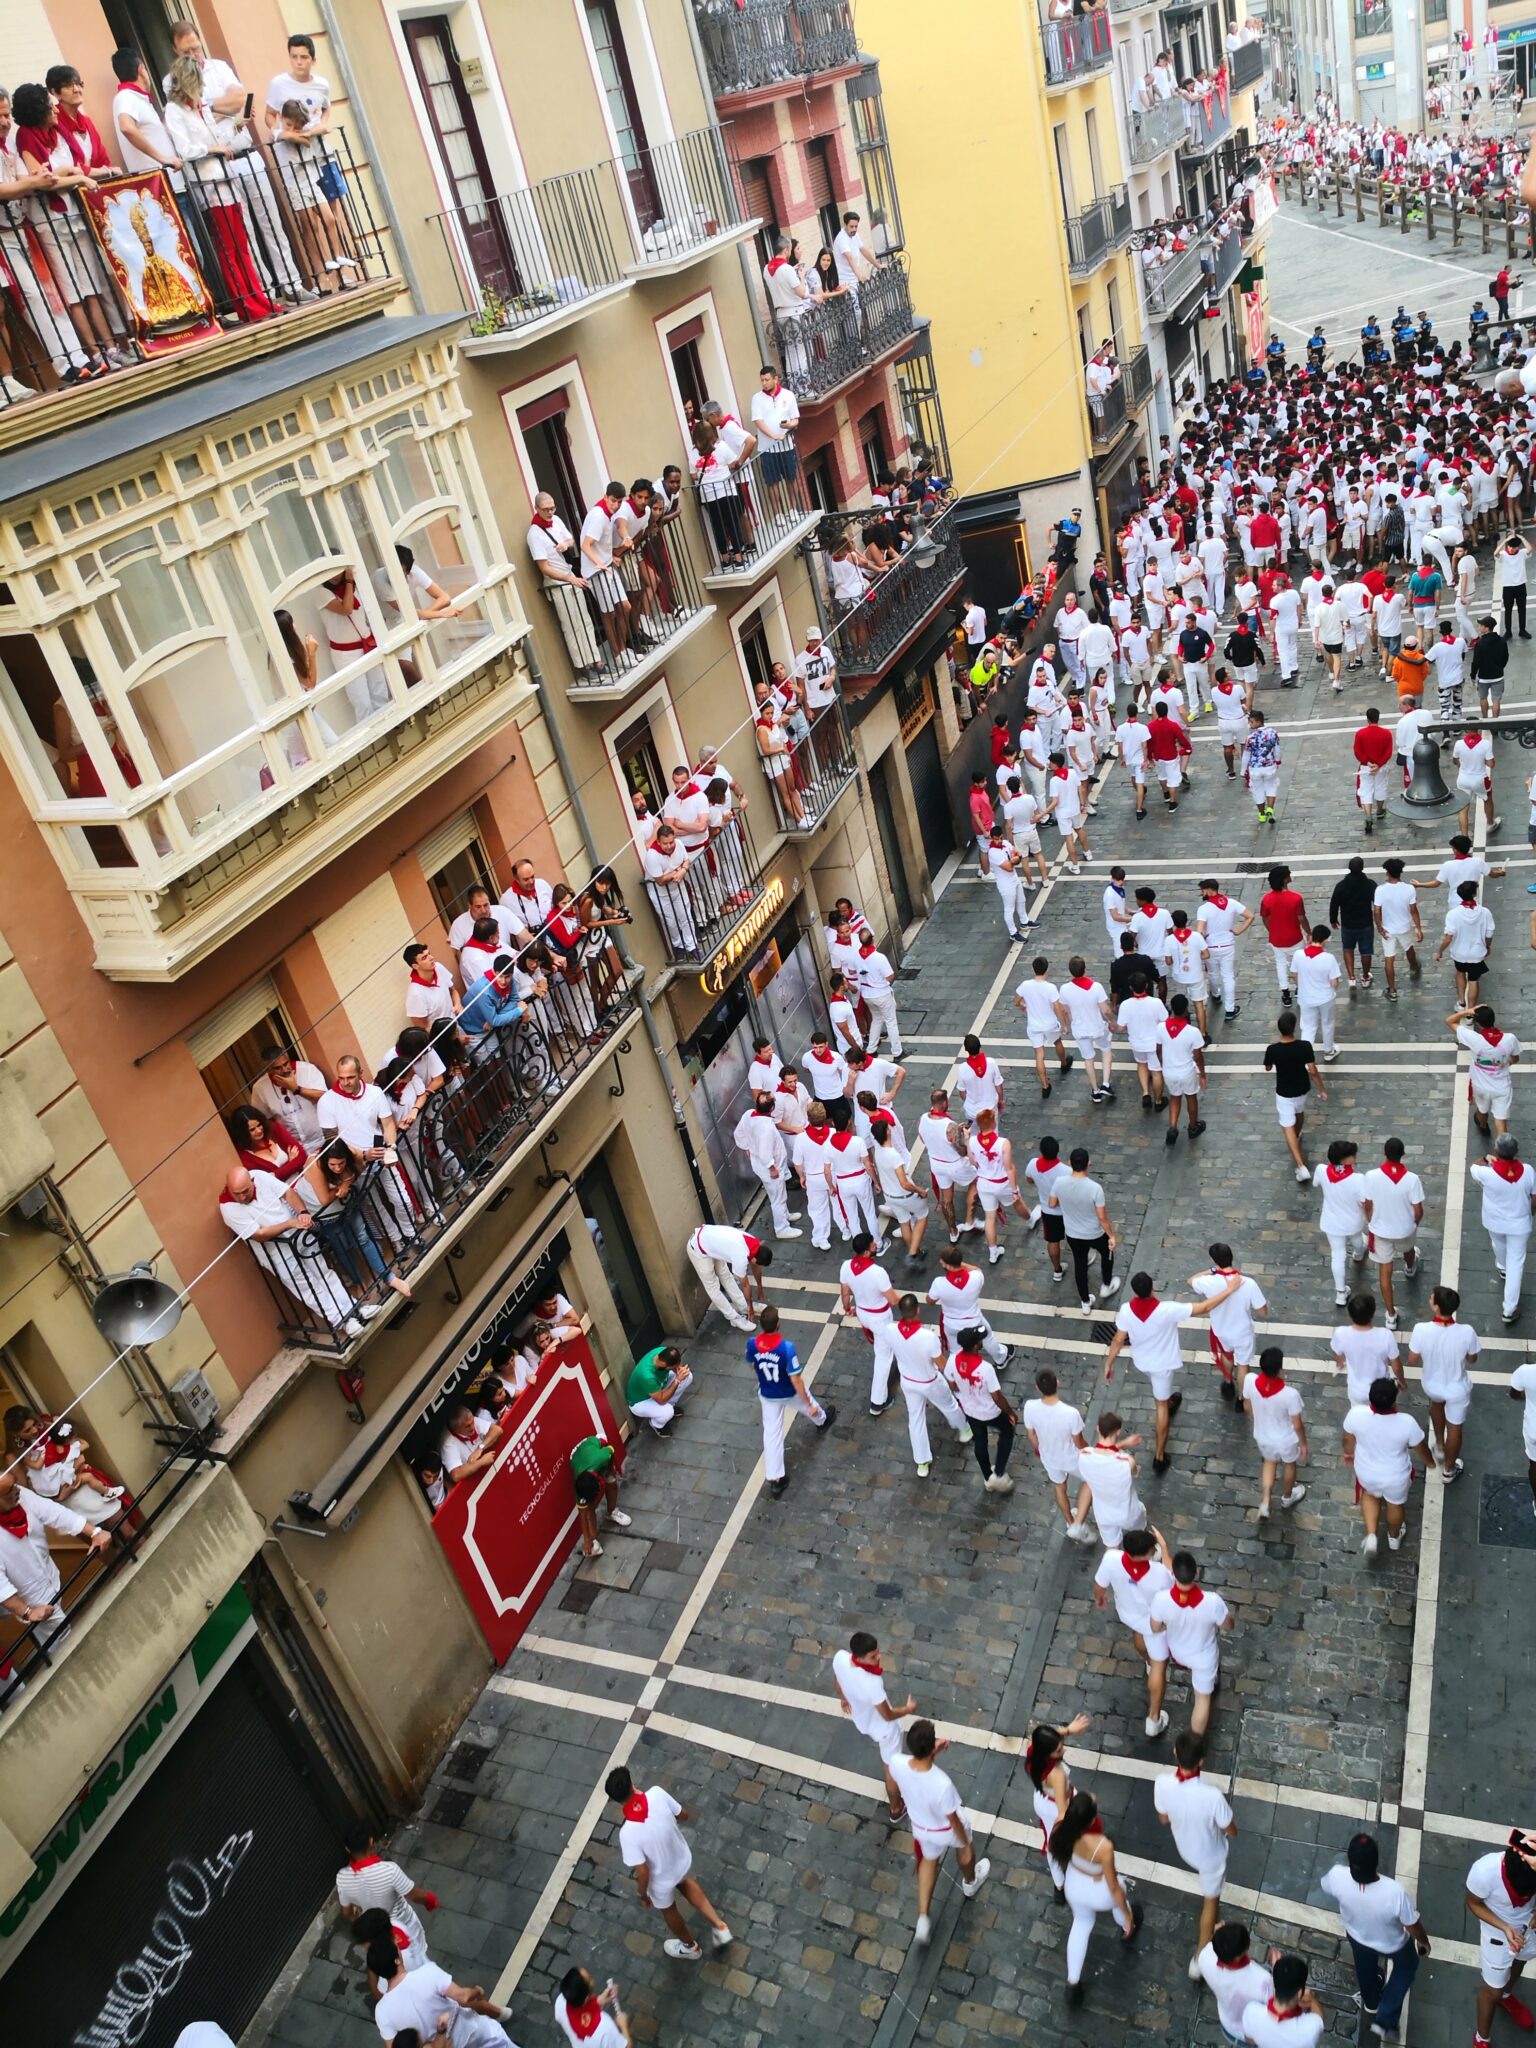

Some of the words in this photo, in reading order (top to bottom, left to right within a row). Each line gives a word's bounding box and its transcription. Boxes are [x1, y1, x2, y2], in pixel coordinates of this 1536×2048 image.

[725, 877, 784, 965] Amorino
[759, 1361, 780, 1383] 17
[519, 1453, 566, 1526] TECNOGALLERY
